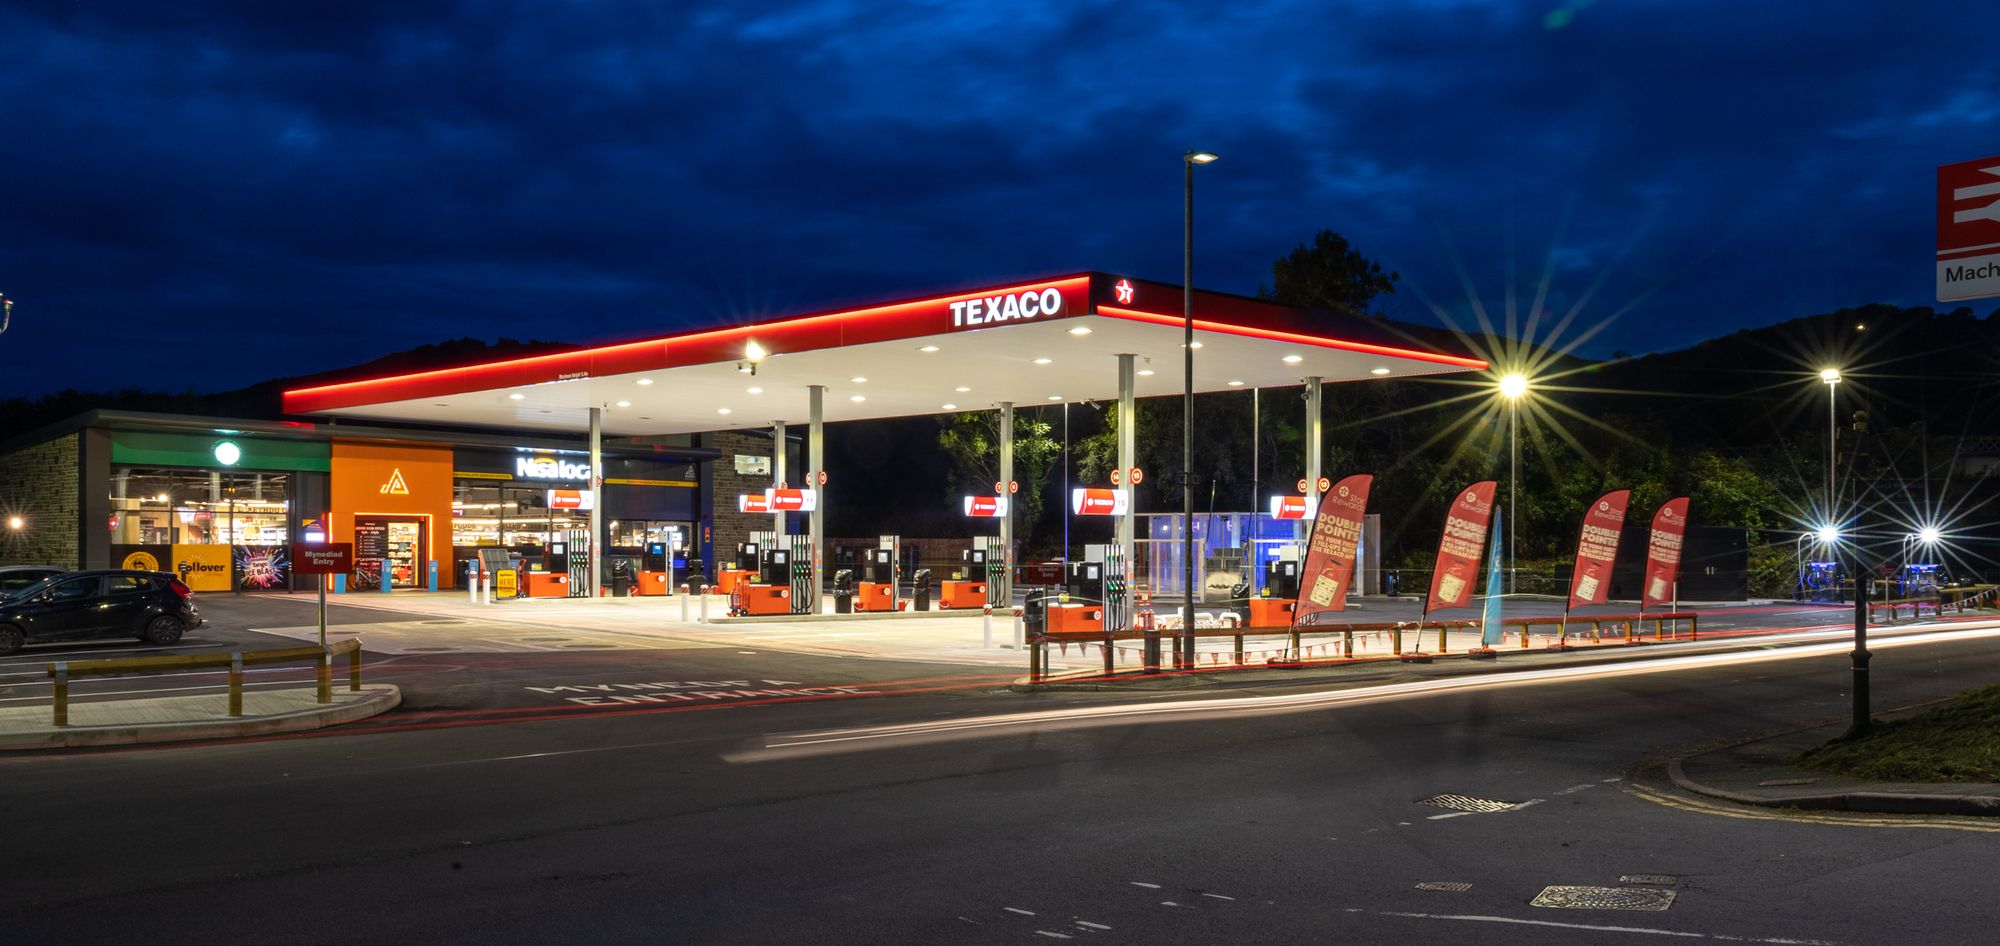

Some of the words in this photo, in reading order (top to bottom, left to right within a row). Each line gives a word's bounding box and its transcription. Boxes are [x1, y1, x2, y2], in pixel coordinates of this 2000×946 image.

[1946, 262, 2000, 283] Mach
[950, 288, 1062, 327] TEXACO
[1316, 522, 1360, 542] POINTS
[1319, 512, 1361, 532] DOUBLE
[1583, 524, 1621, 539] DOUBLE
[1581, 532, 1618, 547] POINTS
[1323, 548, 1345, 558] TEXACO
[499, 578, 515, 586] HERE
[565, 685, 881, 706] ENTRANCE
